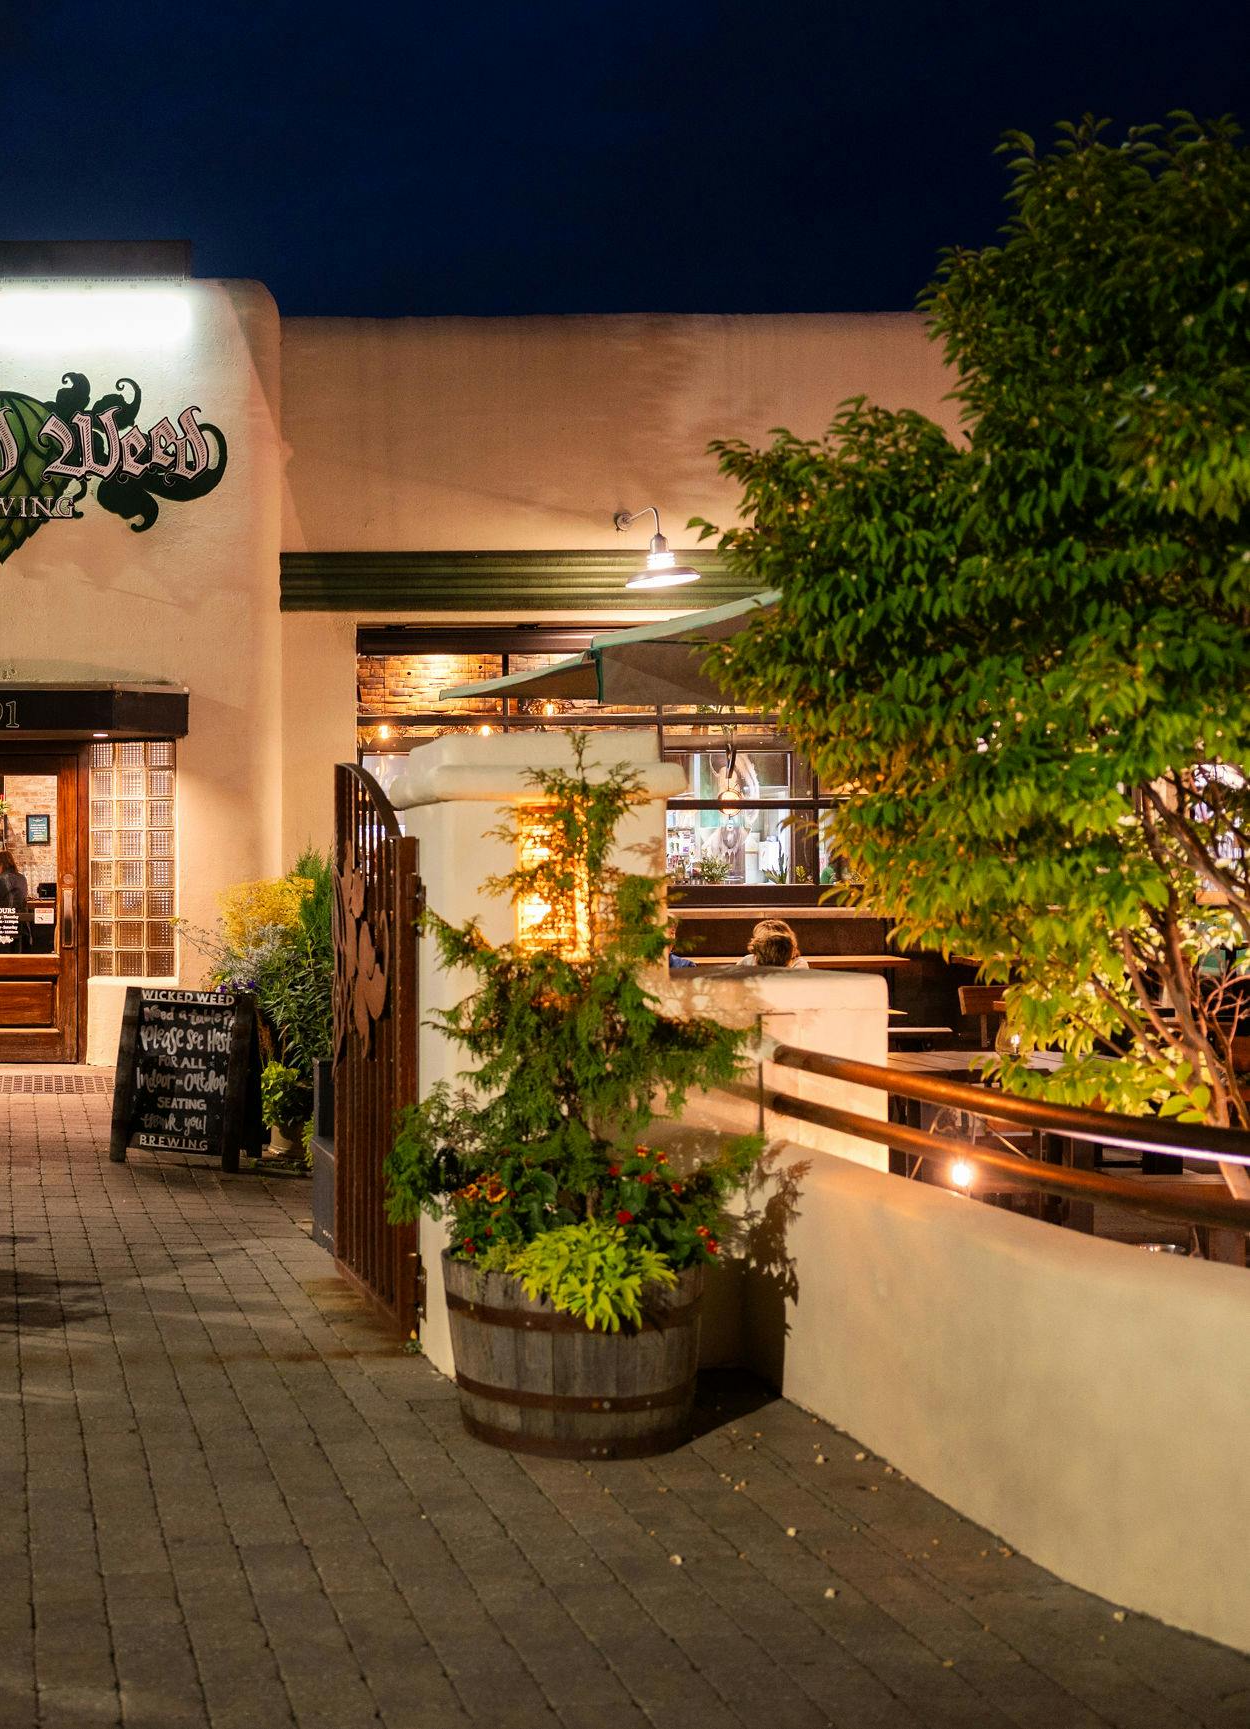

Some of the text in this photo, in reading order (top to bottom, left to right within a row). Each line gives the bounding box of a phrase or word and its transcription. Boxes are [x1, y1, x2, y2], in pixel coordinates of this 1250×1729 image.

[37, 405, 209, 488] Weed
[142, 989, 235, 1006] WICKED WEED
[143, 1004, 175, 1022] Need
[178, 1010, 188, 1020] a
[207, 1028, 233, 1054] Host
[158, 1055, 207, 1069] FOR ALL
[157, 1096, 207, 1111] SEATING
[139, 1134, 208, 1151] BREWING
